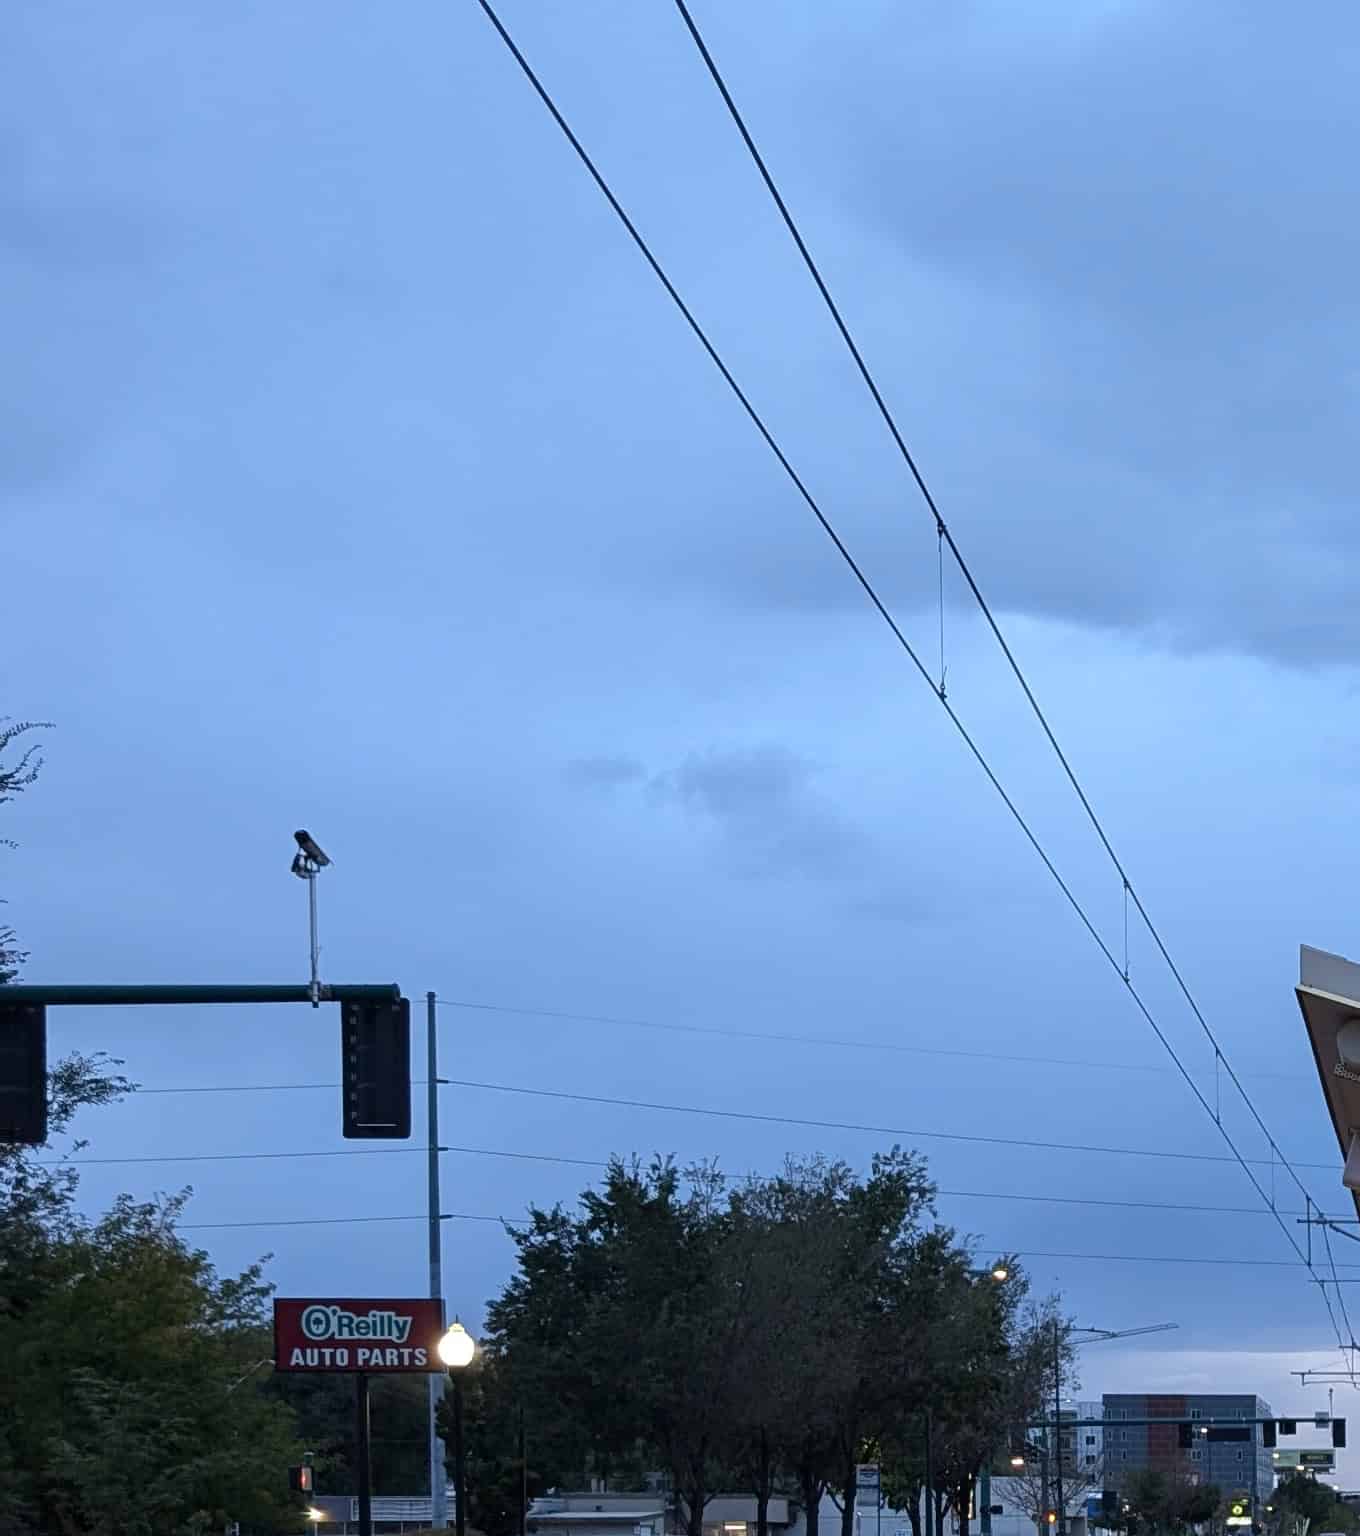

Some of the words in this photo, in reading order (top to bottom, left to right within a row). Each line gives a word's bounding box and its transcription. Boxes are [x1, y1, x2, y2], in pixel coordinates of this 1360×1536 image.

[302, 1305, 412, 1343] O'Reilly
[290, 1348, 349, 1366] AUTO
[357, 1348, 427, 1366] PARTS
